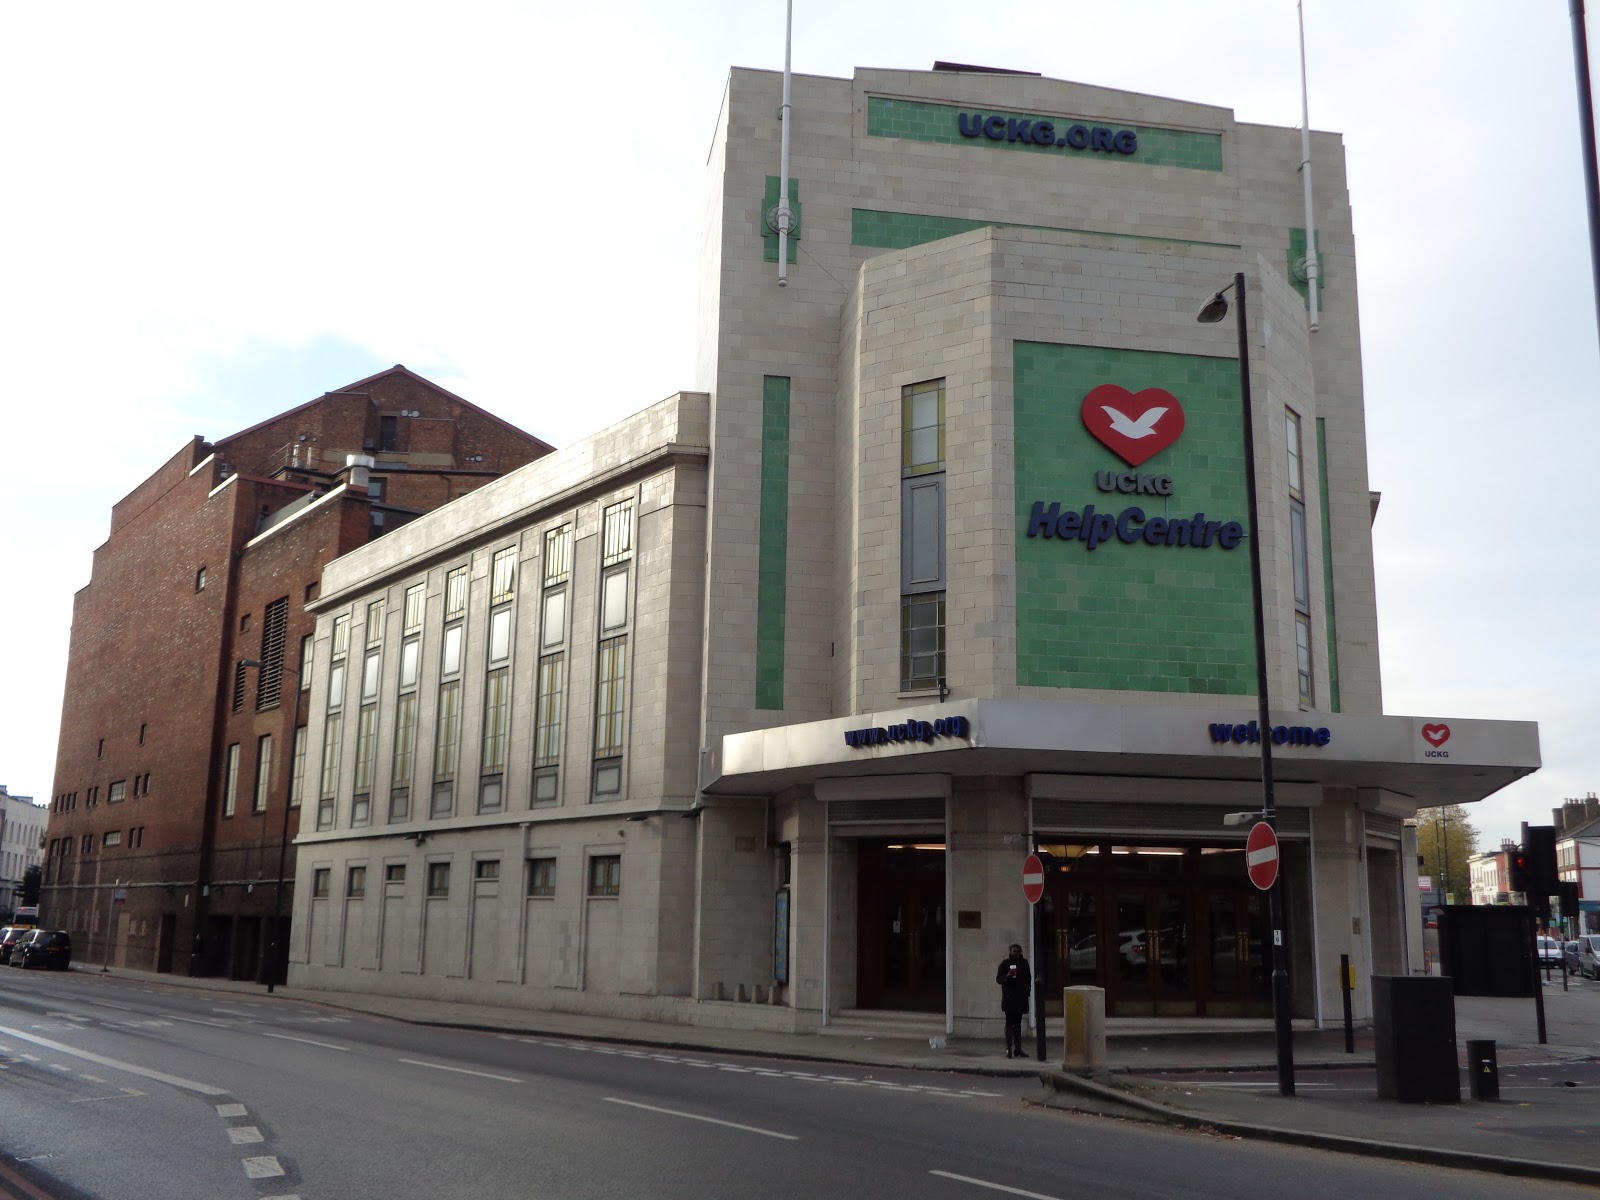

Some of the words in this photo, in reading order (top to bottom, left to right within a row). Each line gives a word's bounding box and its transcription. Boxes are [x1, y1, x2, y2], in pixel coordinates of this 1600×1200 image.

[959, 112, 1138, 155] UCKG.ORG
[1097, 470, 1174, 496] UCKG
[843, 715, 969, 746] www.uckg.org
[1424, 750, 1449, 758] UCKG
